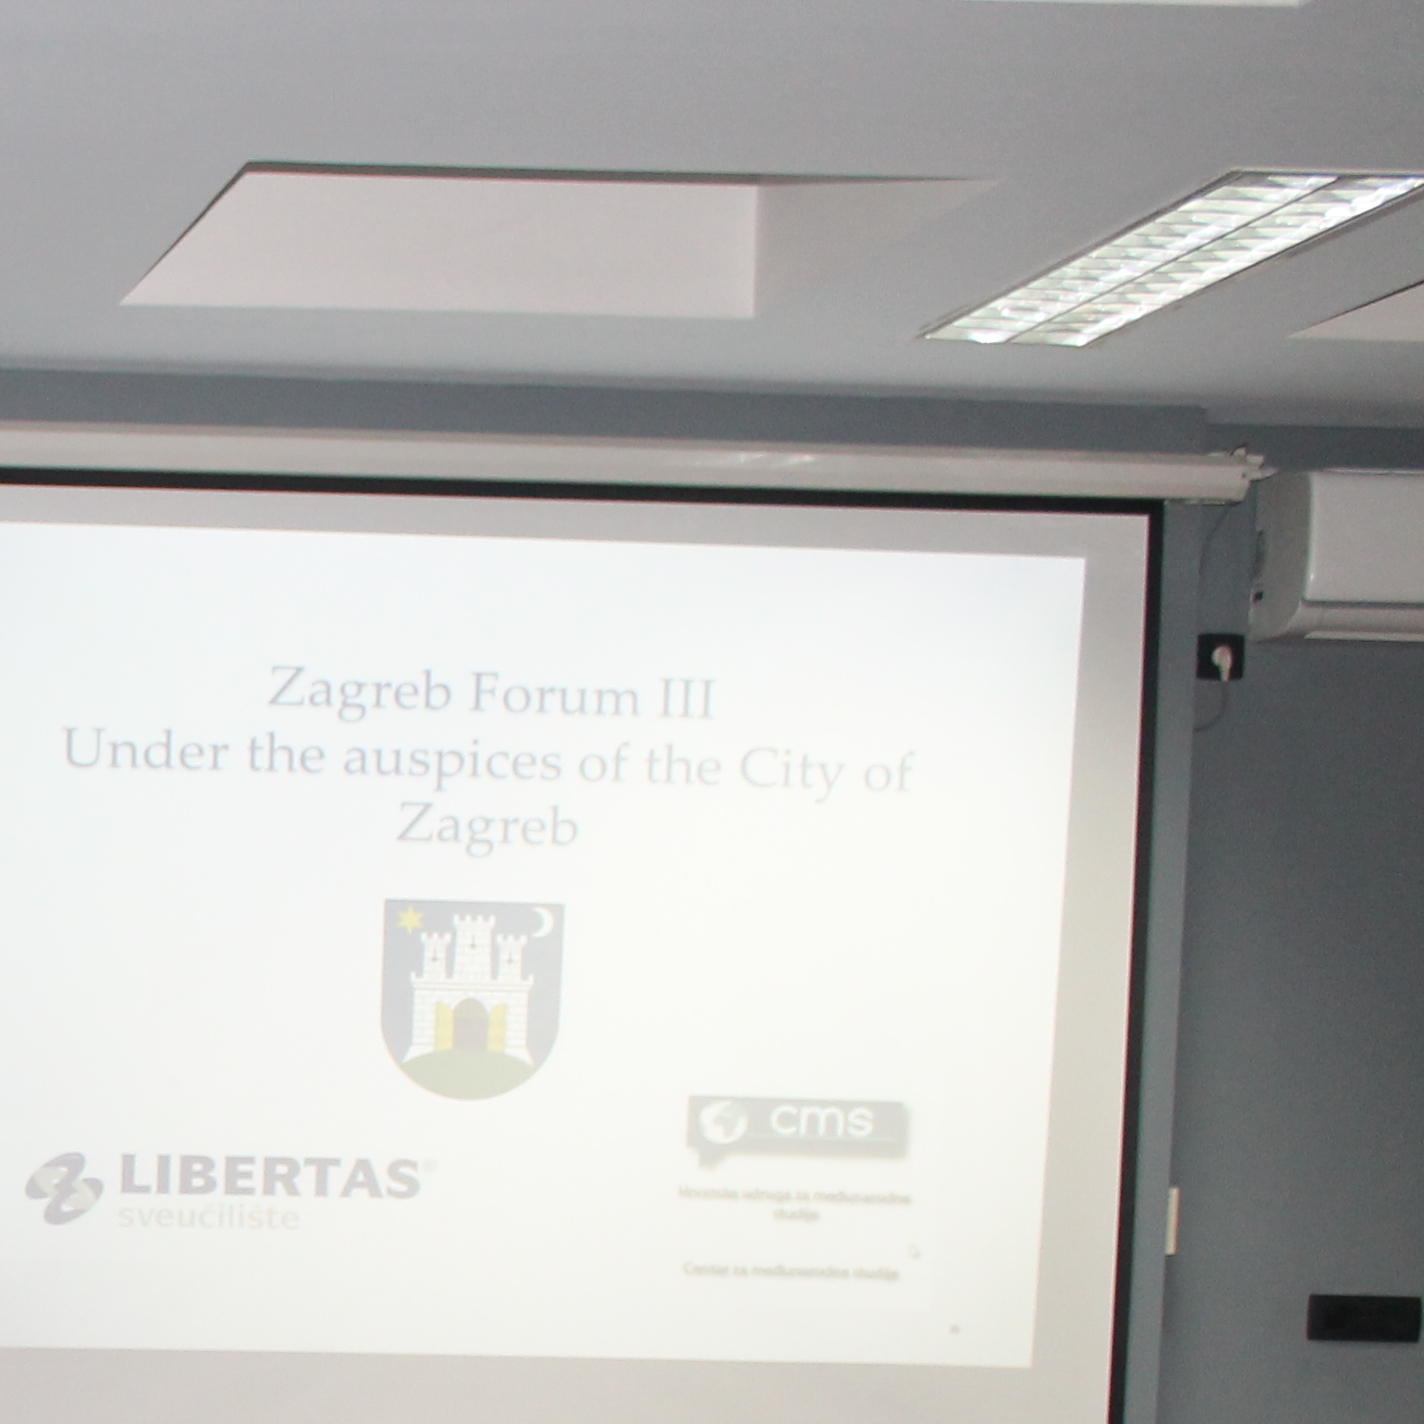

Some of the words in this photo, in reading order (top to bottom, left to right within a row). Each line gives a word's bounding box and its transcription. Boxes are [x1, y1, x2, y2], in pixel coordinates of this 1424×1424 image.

[268, 664, 453, 723] Zagreb
[470, 671, 641, 717] Forum
[659, 677, 716, 720] III
[62, 726, 231, 772] Under
[247, 731, 327, 774] the
[342, 738, 563, 792] auspices
[578, 741, 631, 783] of
[646, 743, 723, 786] the
[739, 746, 846, 804] City
[863, 750, 917, 792] of
[396, 800, 580, 858] Zagreb
[769, 1103, 875, 1138] cms
[119, 1153, 422, 1200] LIBERTAS
[118, 1204, 300, 1231] sveučilište
